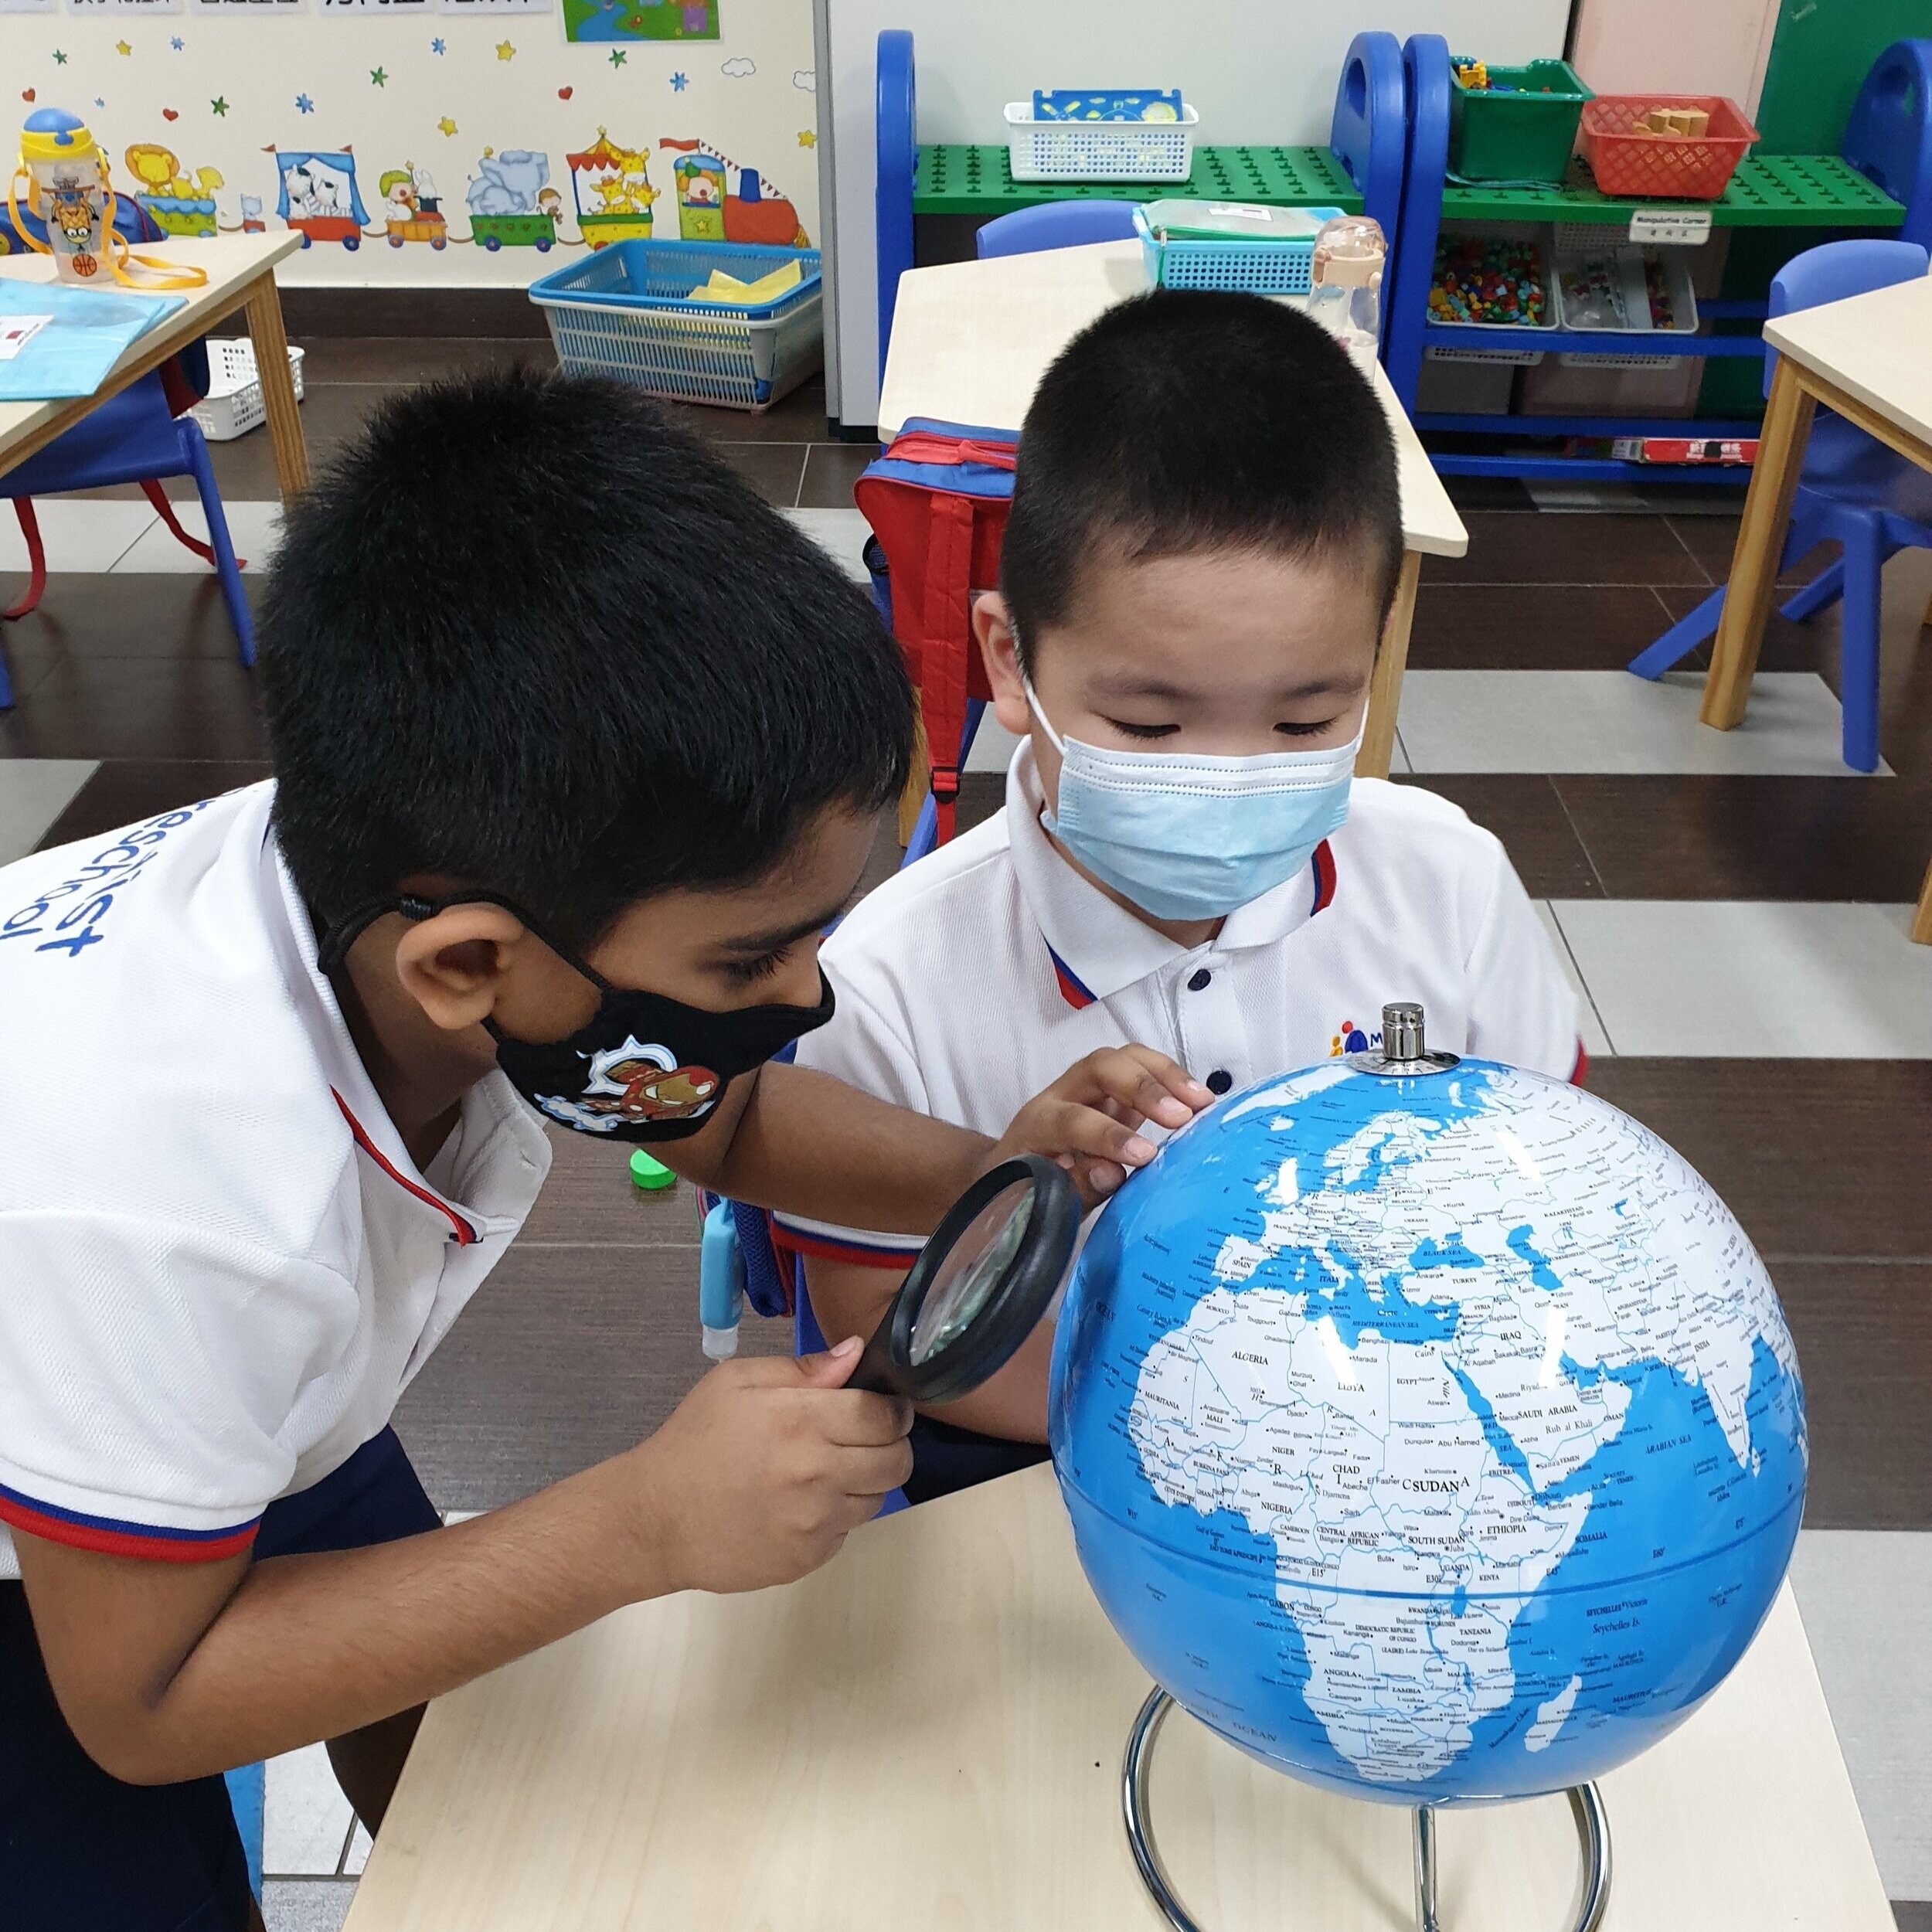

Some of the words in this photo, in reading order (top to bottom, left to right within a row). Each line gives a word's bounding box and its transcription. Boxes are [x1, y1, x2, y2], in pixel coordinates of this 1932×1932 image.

[1232, 1260, 1250, 1268] SPAIN
[1195, 1335, 1213, 1345] Tindouf
[1501, 1332, 1522, 1340] IRAQ
[1695, 1340, 1710, 1352] INDIA
[1415, 1349, 1434, 1358] Cairo
[1232, 1351, 1268, 1366] ALGERIA
[1145, 1391, 1179, 1410] MAURITANIA
[1549, 1406, 1577, 1416] ARABIA
[1206, 1414, 1223, 1423] MALI
[1546, 1425, 1560, 1434] Rub
[1575, 1420, 1593, 1430] Khali
[1645, 1440, 1676, 1454] ARABIAN
[1679, 1434, 1691, 1445] SEA
[1272, 1447, 1294, 1455] NIGER
[1560, 1455, 1580, 1464] YEMEN
[1333, 1465, 1359, 1474] CHAD
[1376, 1476, 1400, 1485] Fasher
[1413, 1481, 1459, 1492] SUDAN
[1261, 1502, 1292, 1515] NIGERIA
[1281, 1524, 1310, 1533] CAMEROON
[1317, 1526, 1346, 1536] CENTRAL
[1488, 1526, 1526, 1534] ETHIOPIA
[1348, 1538, 1379, 1546] REPUBLIC
[1576, 1532, 1607, 1543] SOMALIA
[1270, 1598, 1294, 1611] GABON
[1587, 1604, 1621, 1617] SEYCHELLES
[1355, 1624, 1389, 1633] DEMOCRATIC
[1593, 1618, 1630, 1636] Seychelles
[1343, 1630, 1369, 1638] Kananga
[1324, 1668, 1355, 1677] ANGOLA
